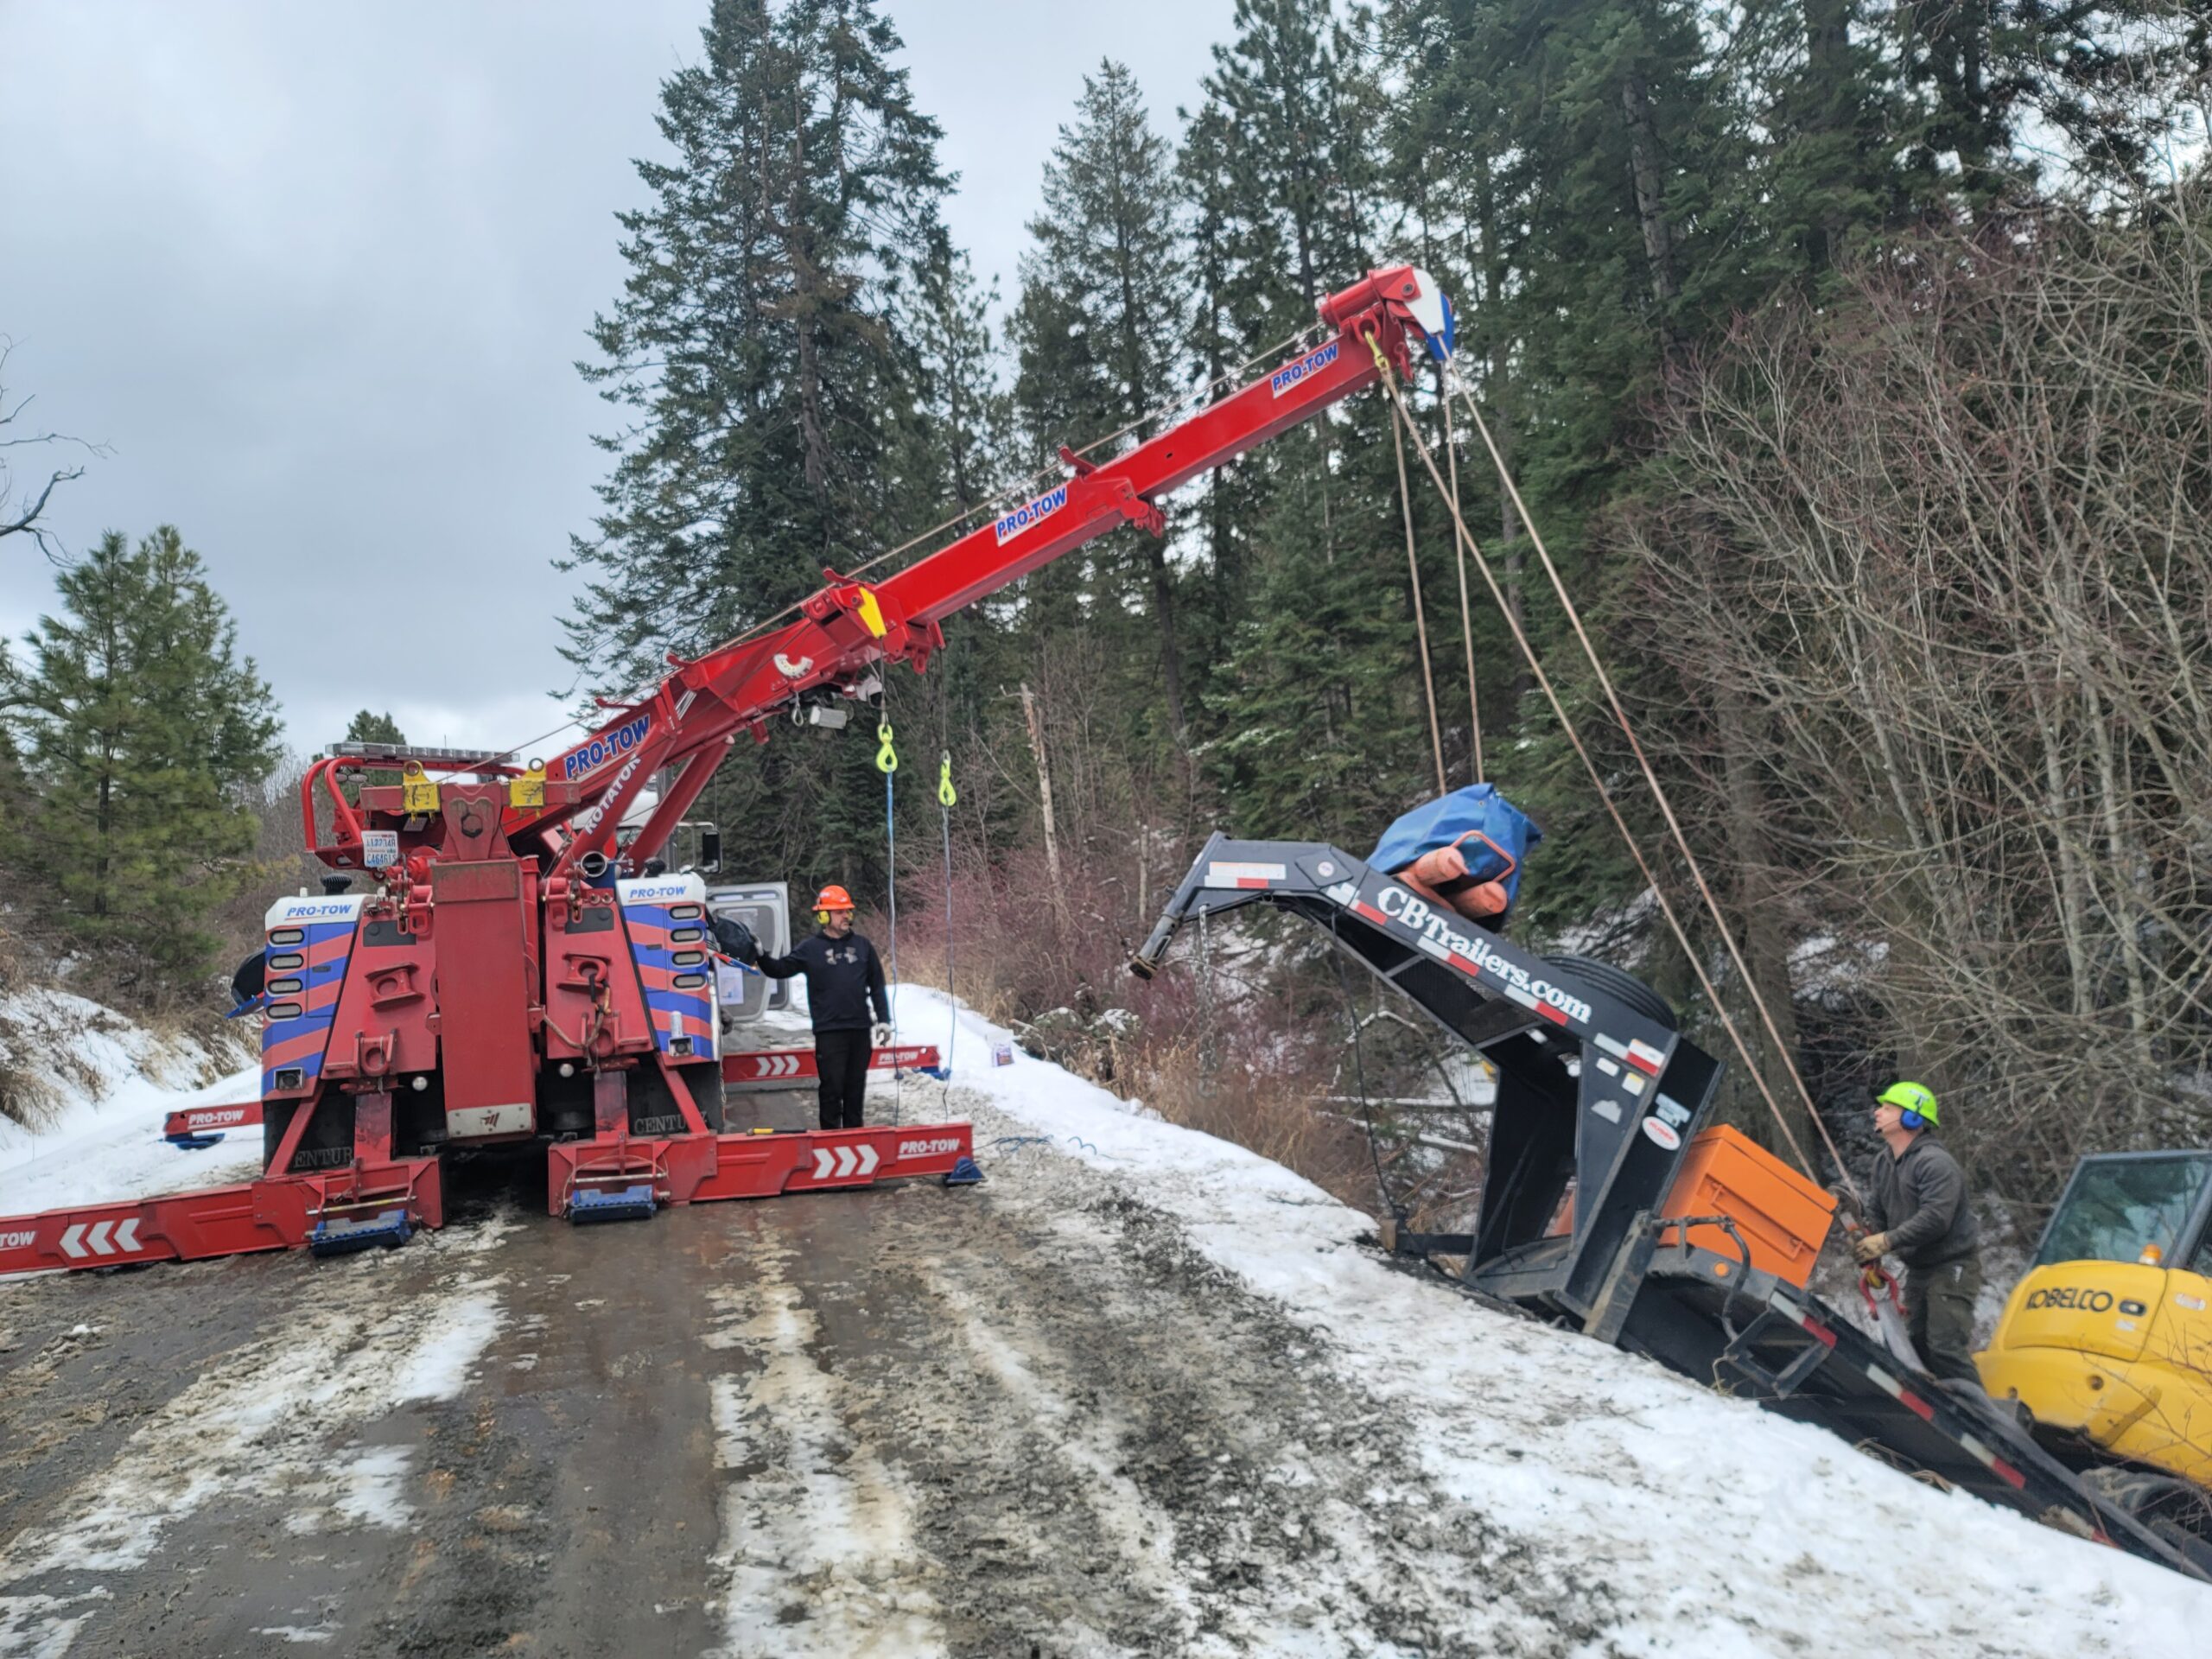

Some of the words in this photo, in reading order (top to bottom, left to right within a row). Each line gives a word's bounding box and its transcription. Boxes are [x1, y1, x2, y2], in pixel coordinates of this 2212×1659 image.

[1272, 343, 1338, 391] PRO-TOW
[996, 486, 1066, 538] PRO-TOW
[565, 715, 650, 779] PRO-TOW
[629, 886, 687, 899] PRO-TOW
[287, 905, 353, 917] PRO-TOW
[1377, 886, 1592, 1025] CBTrailers.com
[188, 1109, 245, 1125] PRO-TOW
[899, 1138, 961, 1154] PRO-TOW
